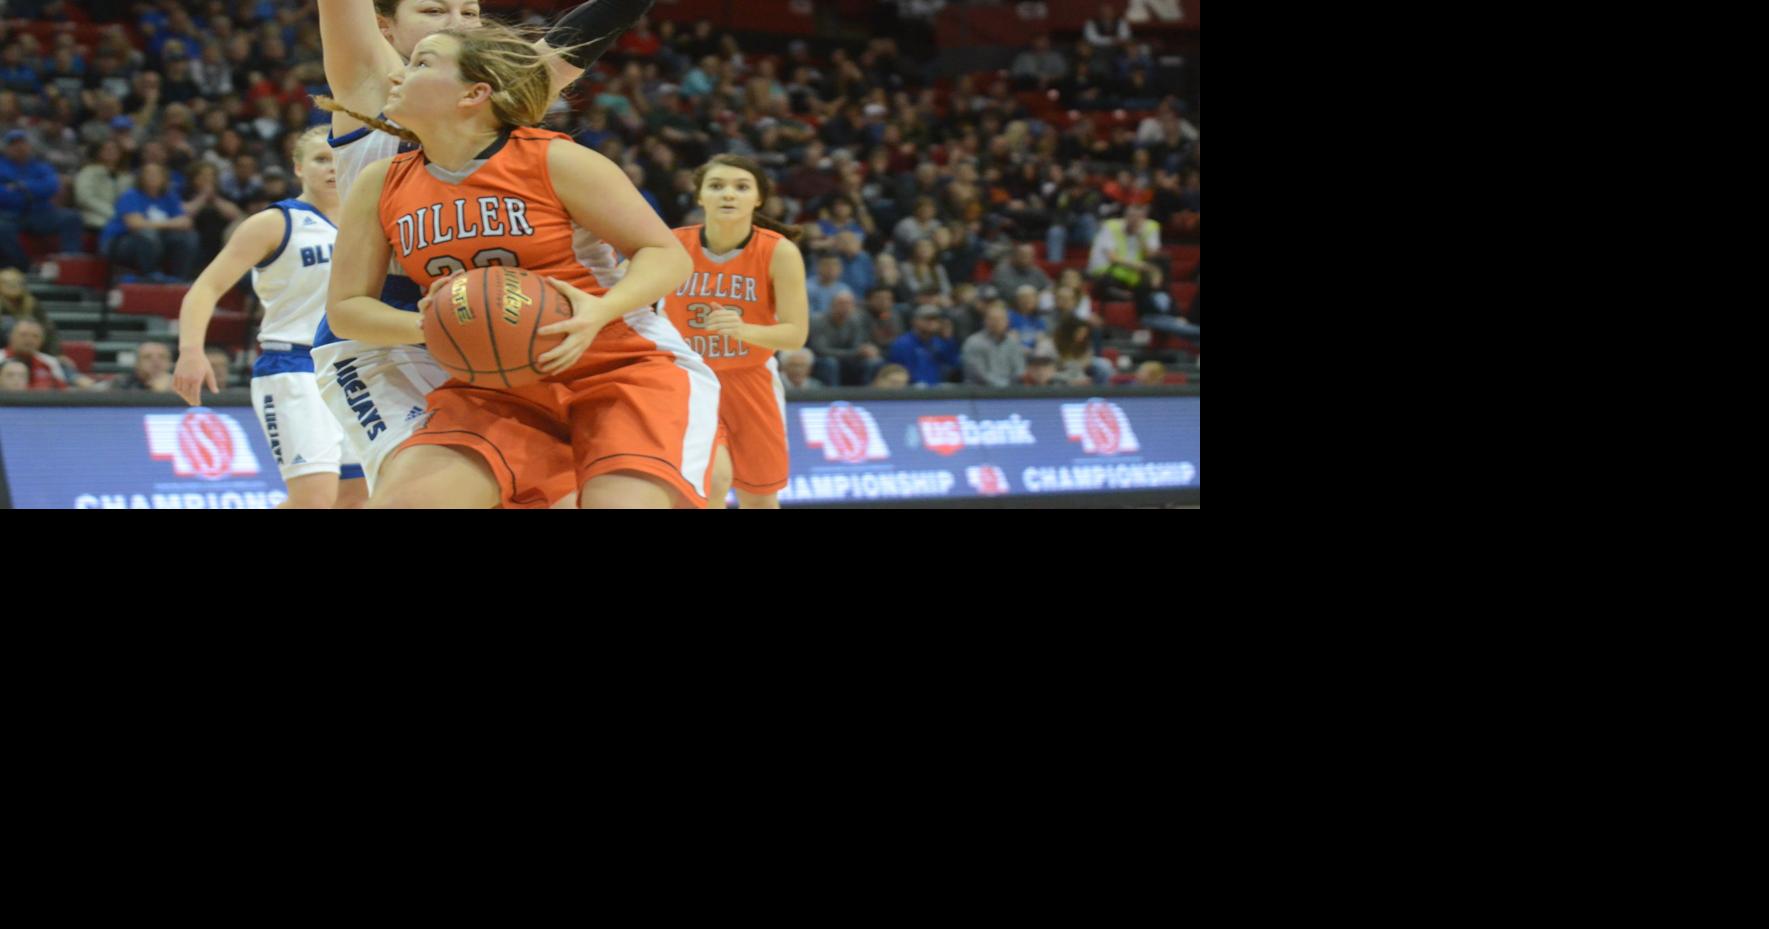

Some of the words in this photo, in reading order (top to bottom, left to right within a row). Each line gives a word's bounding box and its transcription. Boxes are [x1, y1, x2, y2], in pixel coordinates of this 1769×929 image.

[397, 196, 534, 257] DILLER
[299, 243, 334, 268] BL
[687, 303, 744, 328] 3
[685, 334, 749, 358] DELL
[777, 470, 955, 500] HAMPIONSHIP
[1022, 461, 1196, 491] CHAMPIONSHIP
